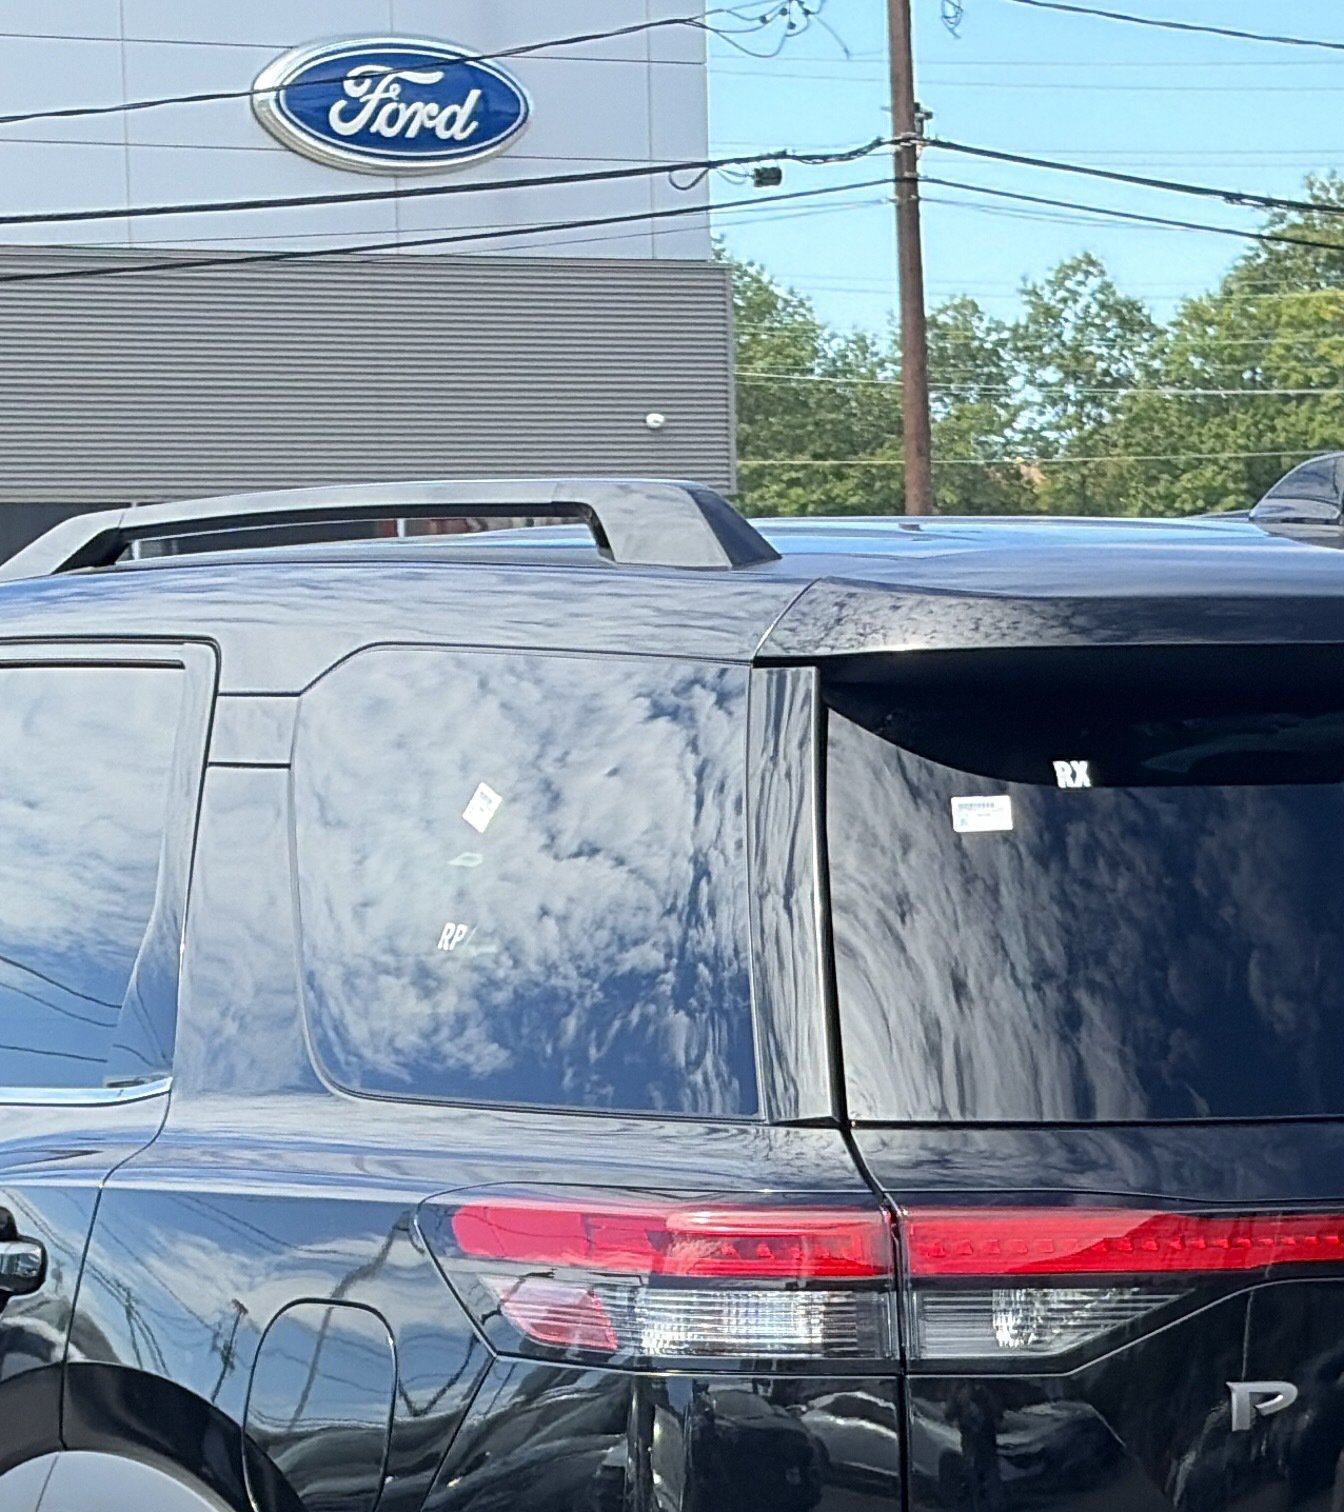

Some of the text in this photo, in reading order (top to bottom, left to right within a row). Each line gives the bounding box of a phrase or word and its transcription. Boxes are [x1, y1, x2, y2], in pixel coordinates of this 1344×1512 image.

[328, 64, 482, 141] Ford
[1052, 760, 1091, 788] RX
[437, 922, 468, 951] RP
